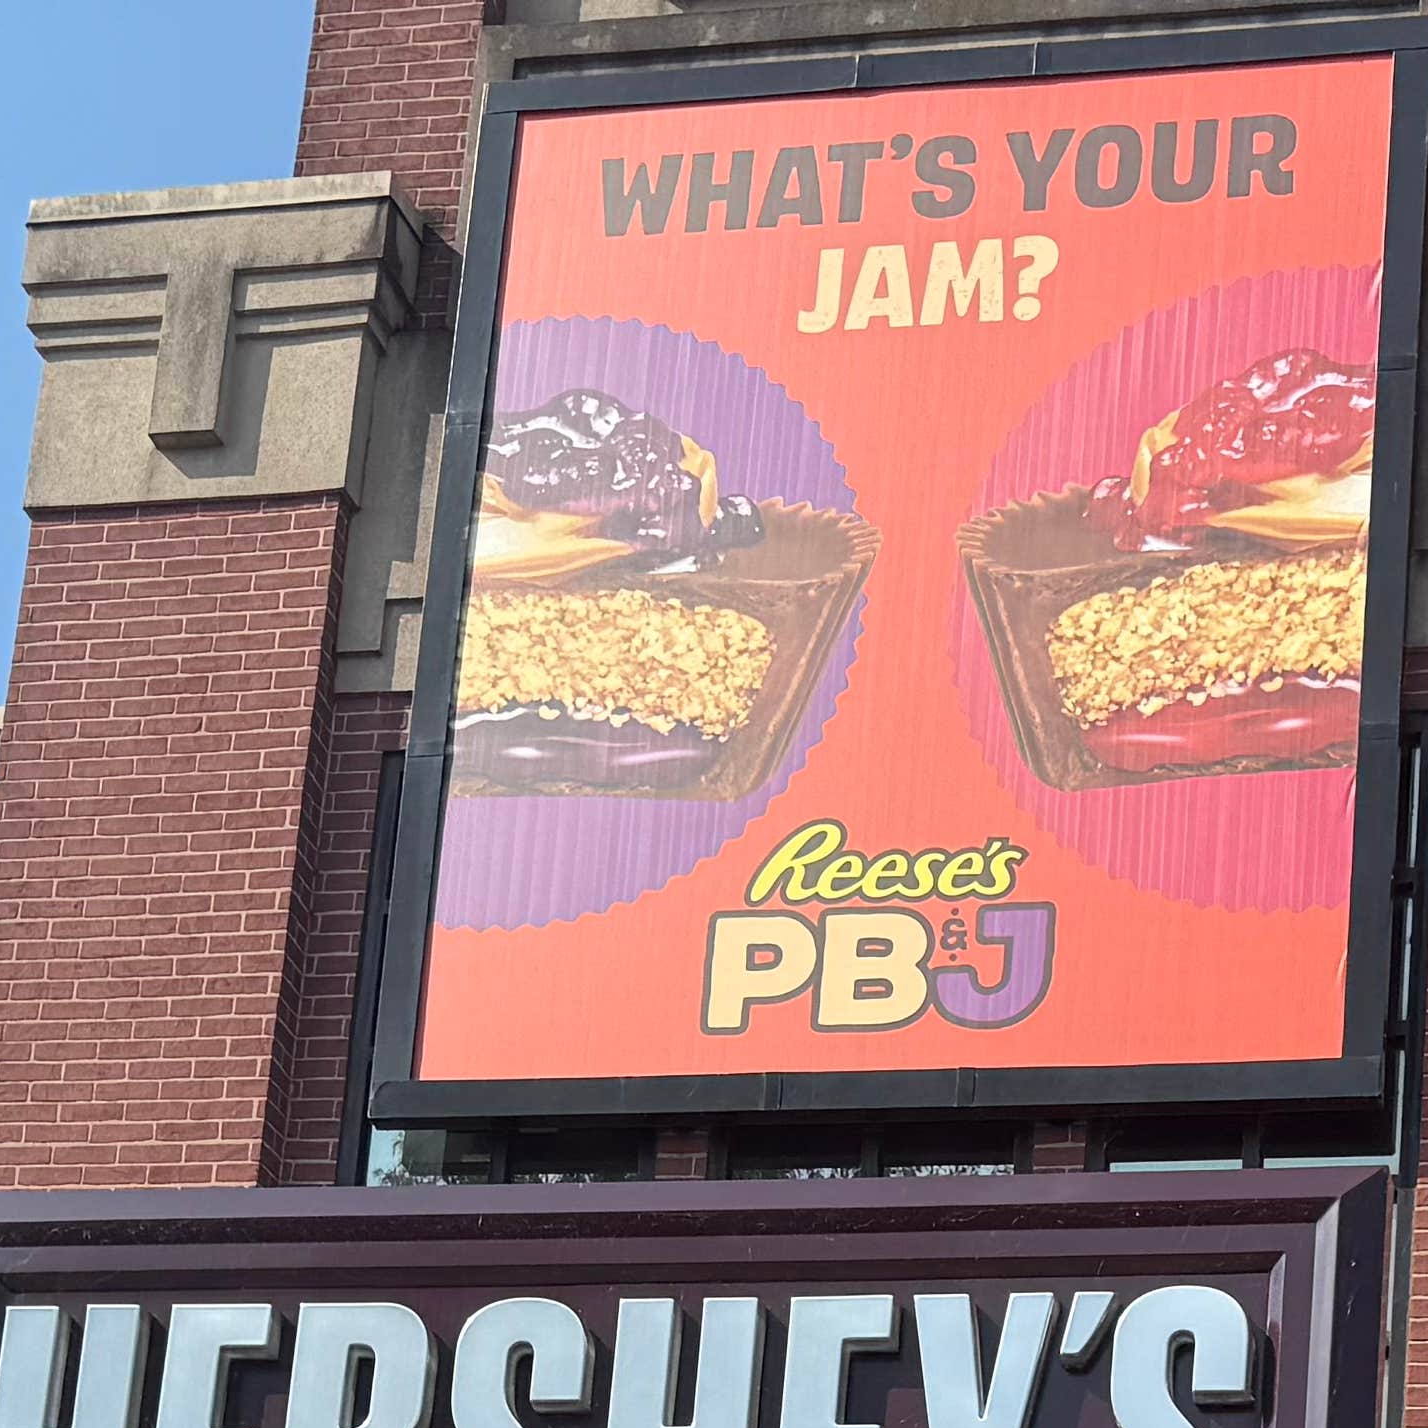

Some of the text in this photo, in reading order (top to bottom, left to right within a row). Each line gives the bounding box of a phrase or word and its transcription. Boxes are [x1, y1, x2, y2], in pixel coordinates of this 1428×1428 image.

[600, 113, 1298, 238] WHAT'S YOUR
[796, 234, 1061, 335] JAM?
[746, 819, 1026, 906] Reese's
